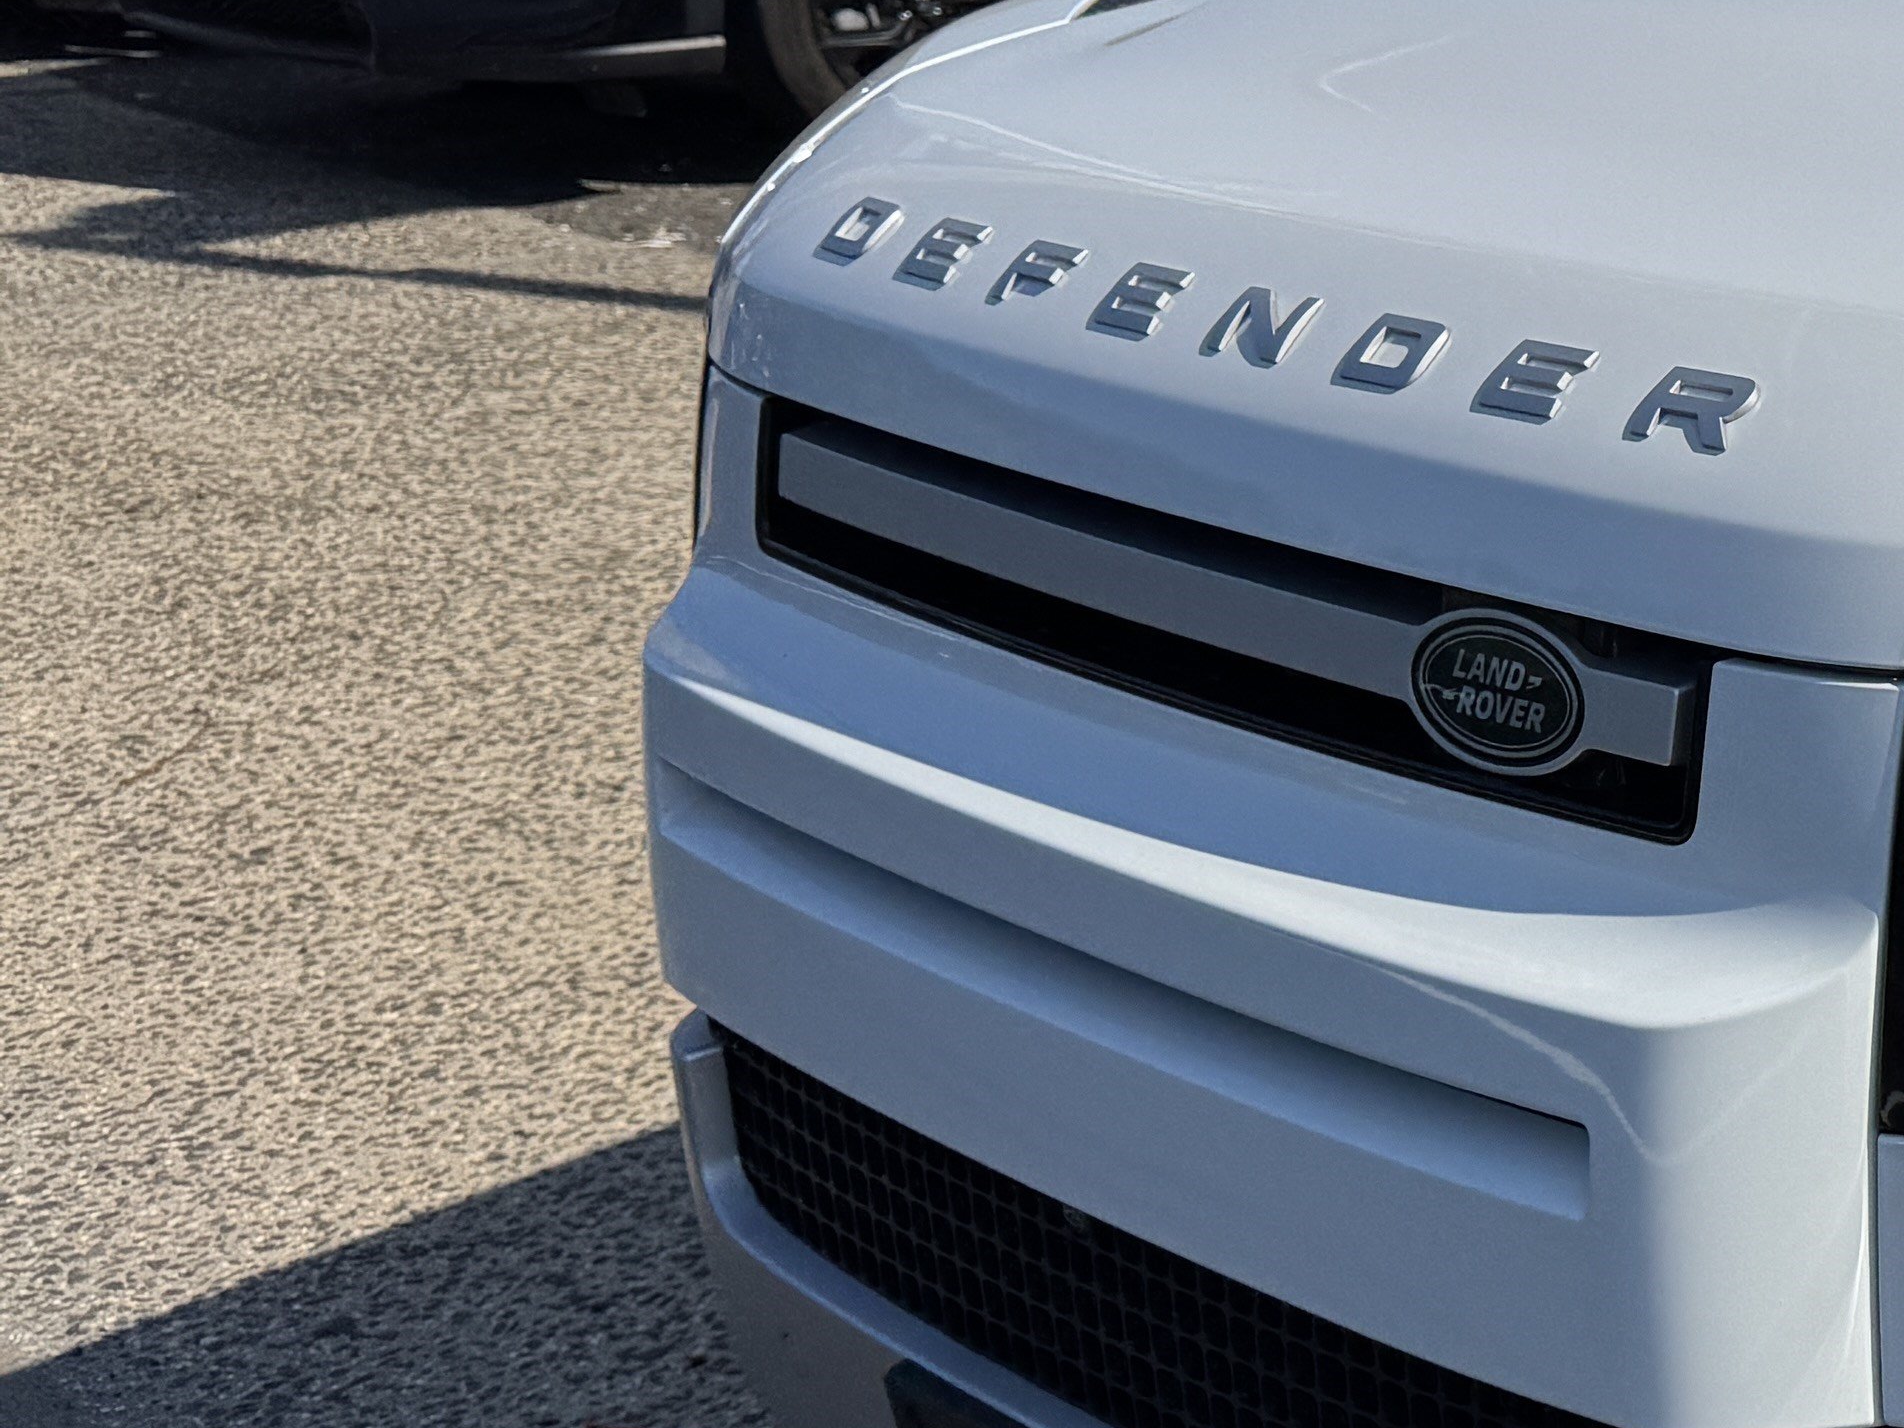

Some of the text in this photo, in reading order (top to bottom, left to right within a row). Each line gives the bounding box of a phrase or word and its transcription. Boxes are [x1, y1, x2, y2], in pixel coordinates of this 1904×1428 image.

[812, 196, 1762, 456] DEFENDER
[1452, 648, 1526, 692] LAND
[1456, 684, 1546, 734] ROVER
